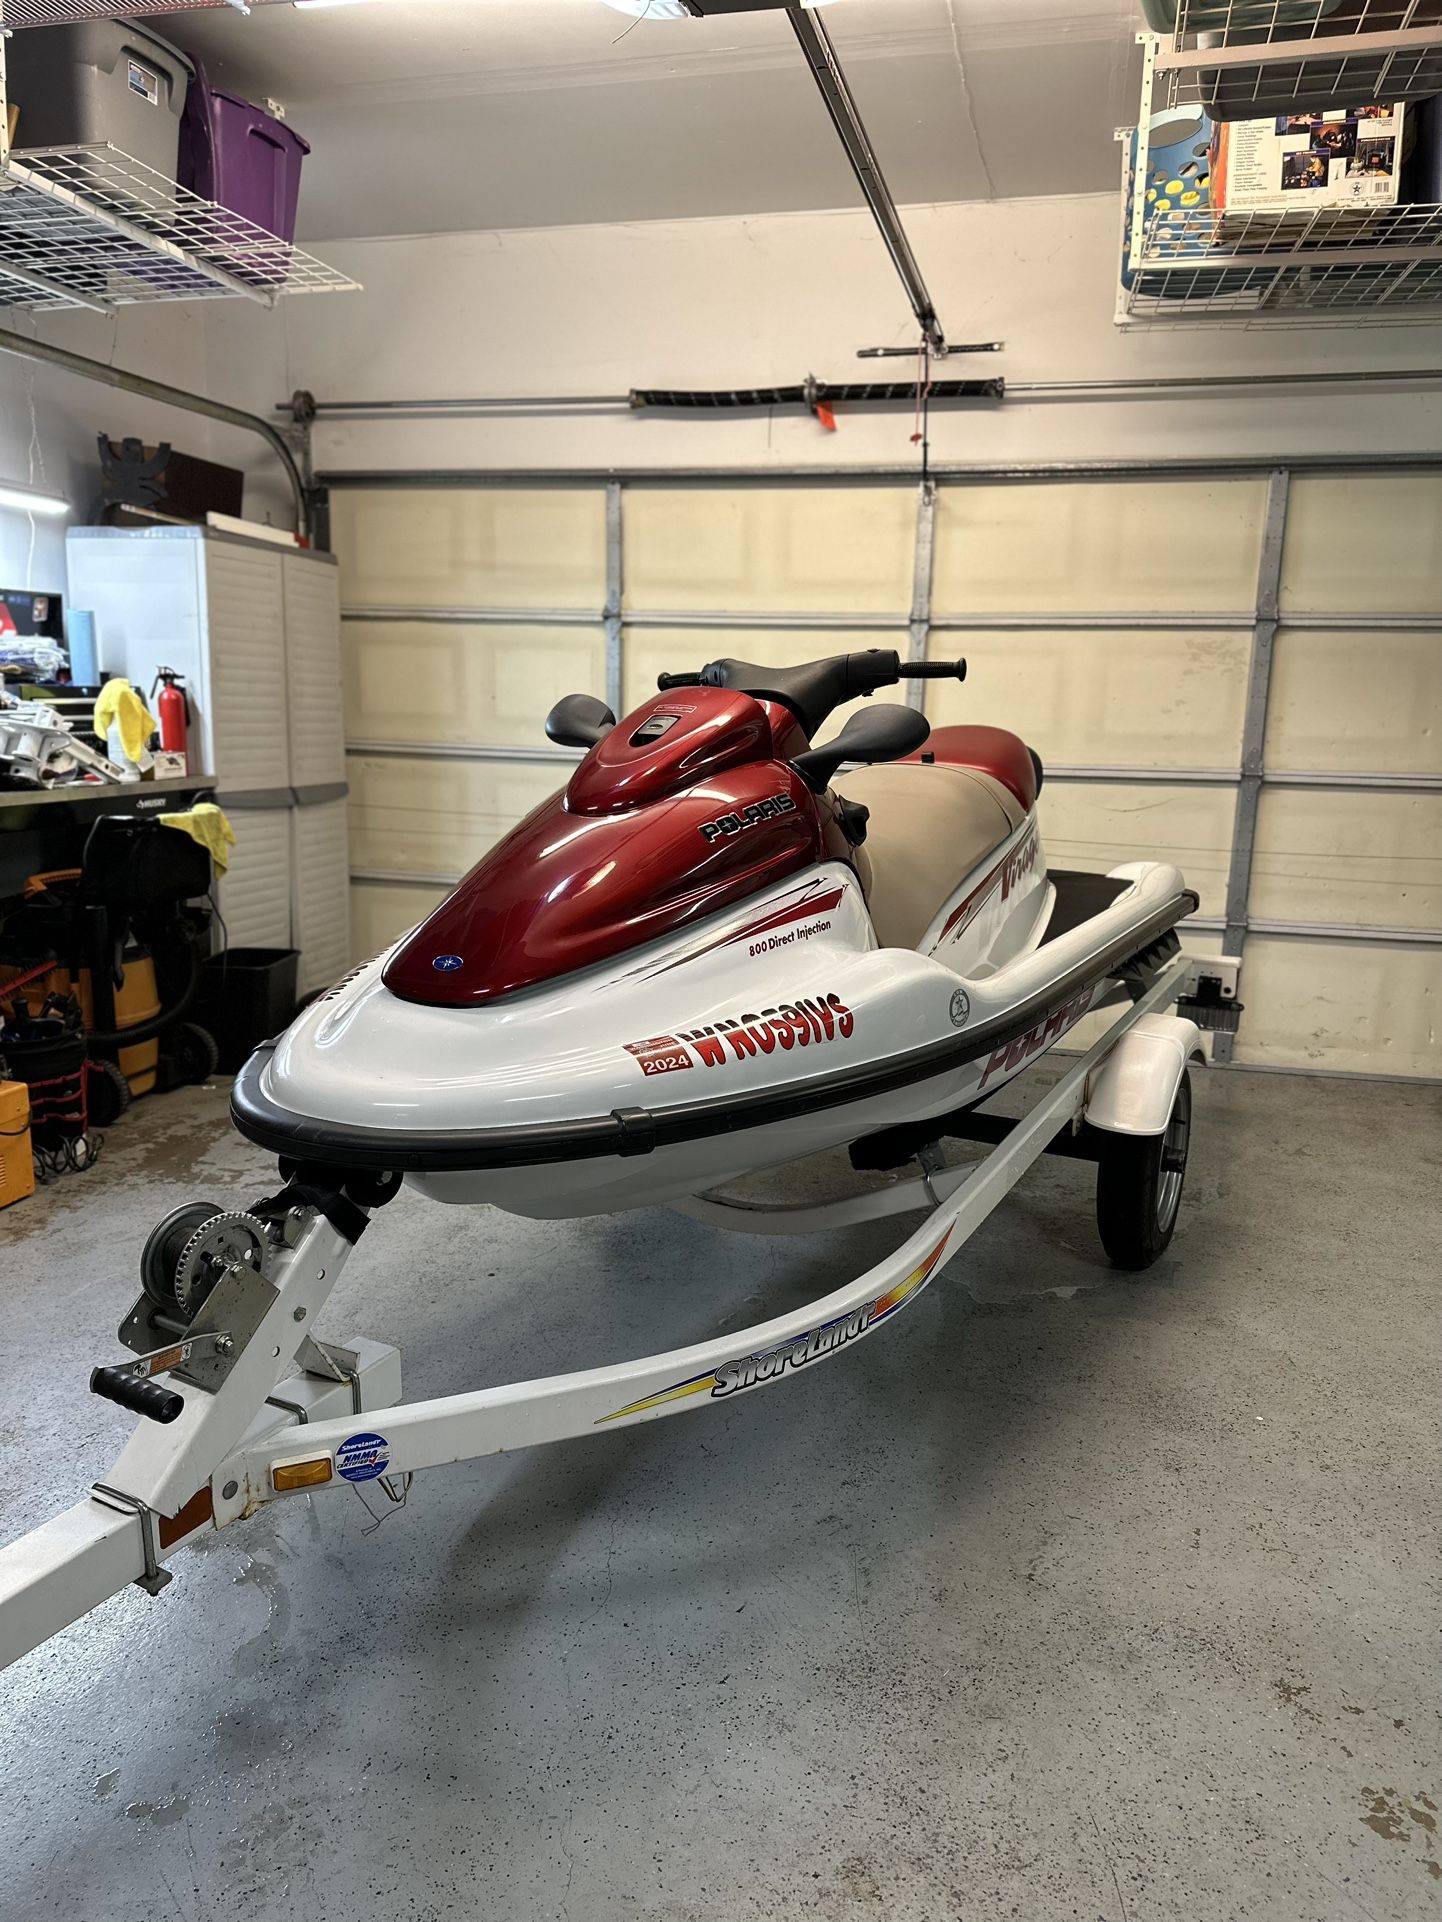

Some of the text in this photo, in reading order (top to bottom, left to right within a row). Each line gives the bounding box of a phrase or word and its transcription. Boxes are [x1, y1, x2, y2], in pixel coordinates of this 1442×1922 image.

[697, 792, 796, 843] POLARIS
[749, 920, 831, 957] 800 Direct Injection
[643, 1054, 690, 1074] 2024
[343, 1449, 378, 1464] NMMA
